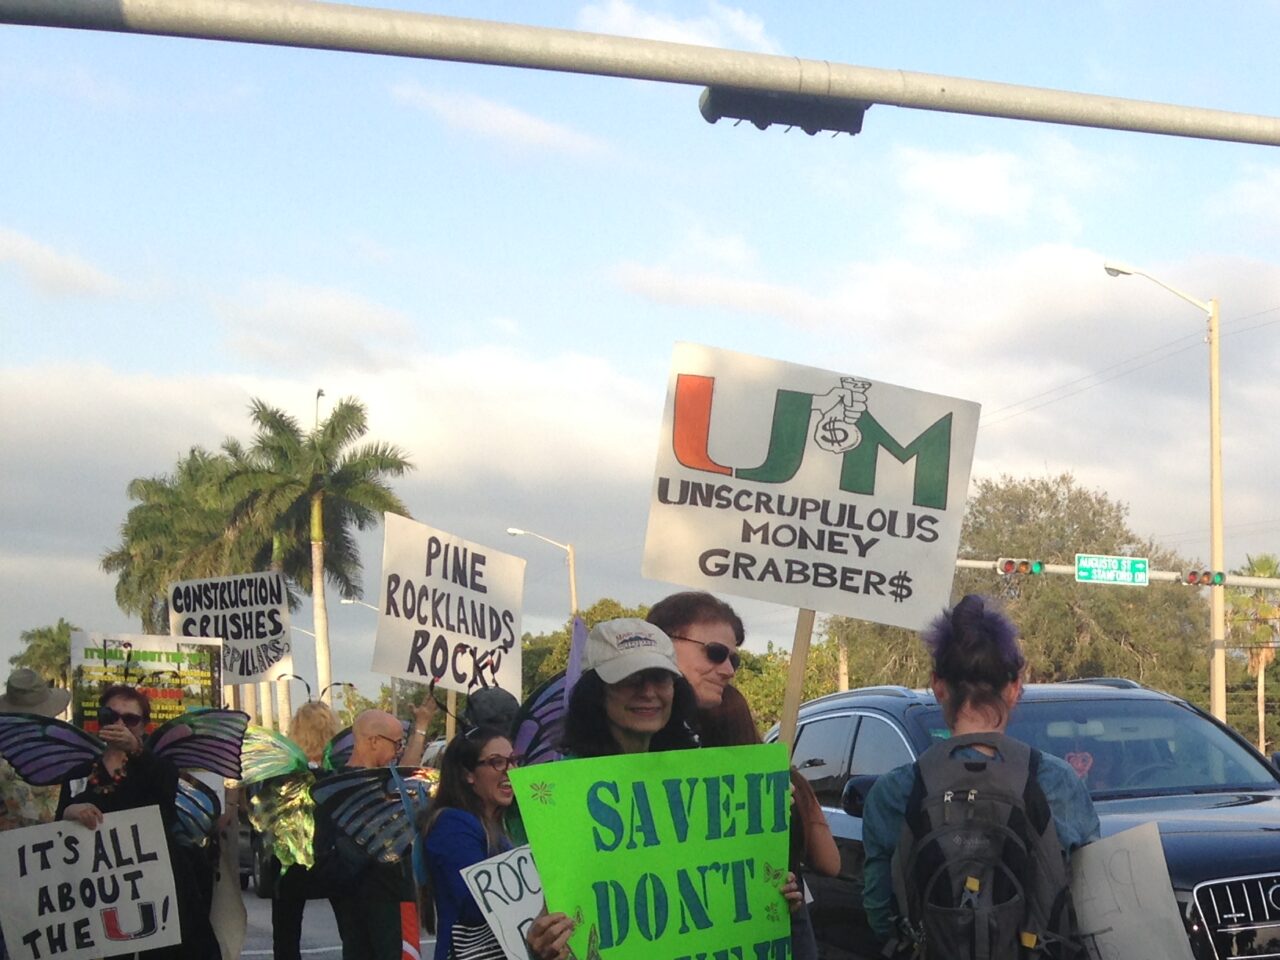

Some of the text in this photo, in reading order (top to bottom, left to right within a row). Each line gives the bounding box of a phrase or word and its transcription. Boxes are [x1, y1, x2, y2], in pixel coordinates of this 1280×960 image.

[657, 477, 939, 542] UNSCRUPULOUS
[426, 536, 487, 593] PINE
[741, 519, 880, 558] MONEY
[172, 574, 282, 613] CONSTRUCTION
[699, 549, 913, 602] GRABBER$
[182, 608, 282, 640] CRUSHES
[386, 573, 514, 649] ROCKLANDS
[222, 639, 284, 676] RPILLARS
[587, 770, 791, 852] SAVE-IT
[18, 824, 158, 878] IT'S ALL
[38, 870, 143, 917] ABOUT
[474, 853, 541, 913] ROC
[592, 858, 754, 950] DON'T
[23, 918, 95, 960] THE
